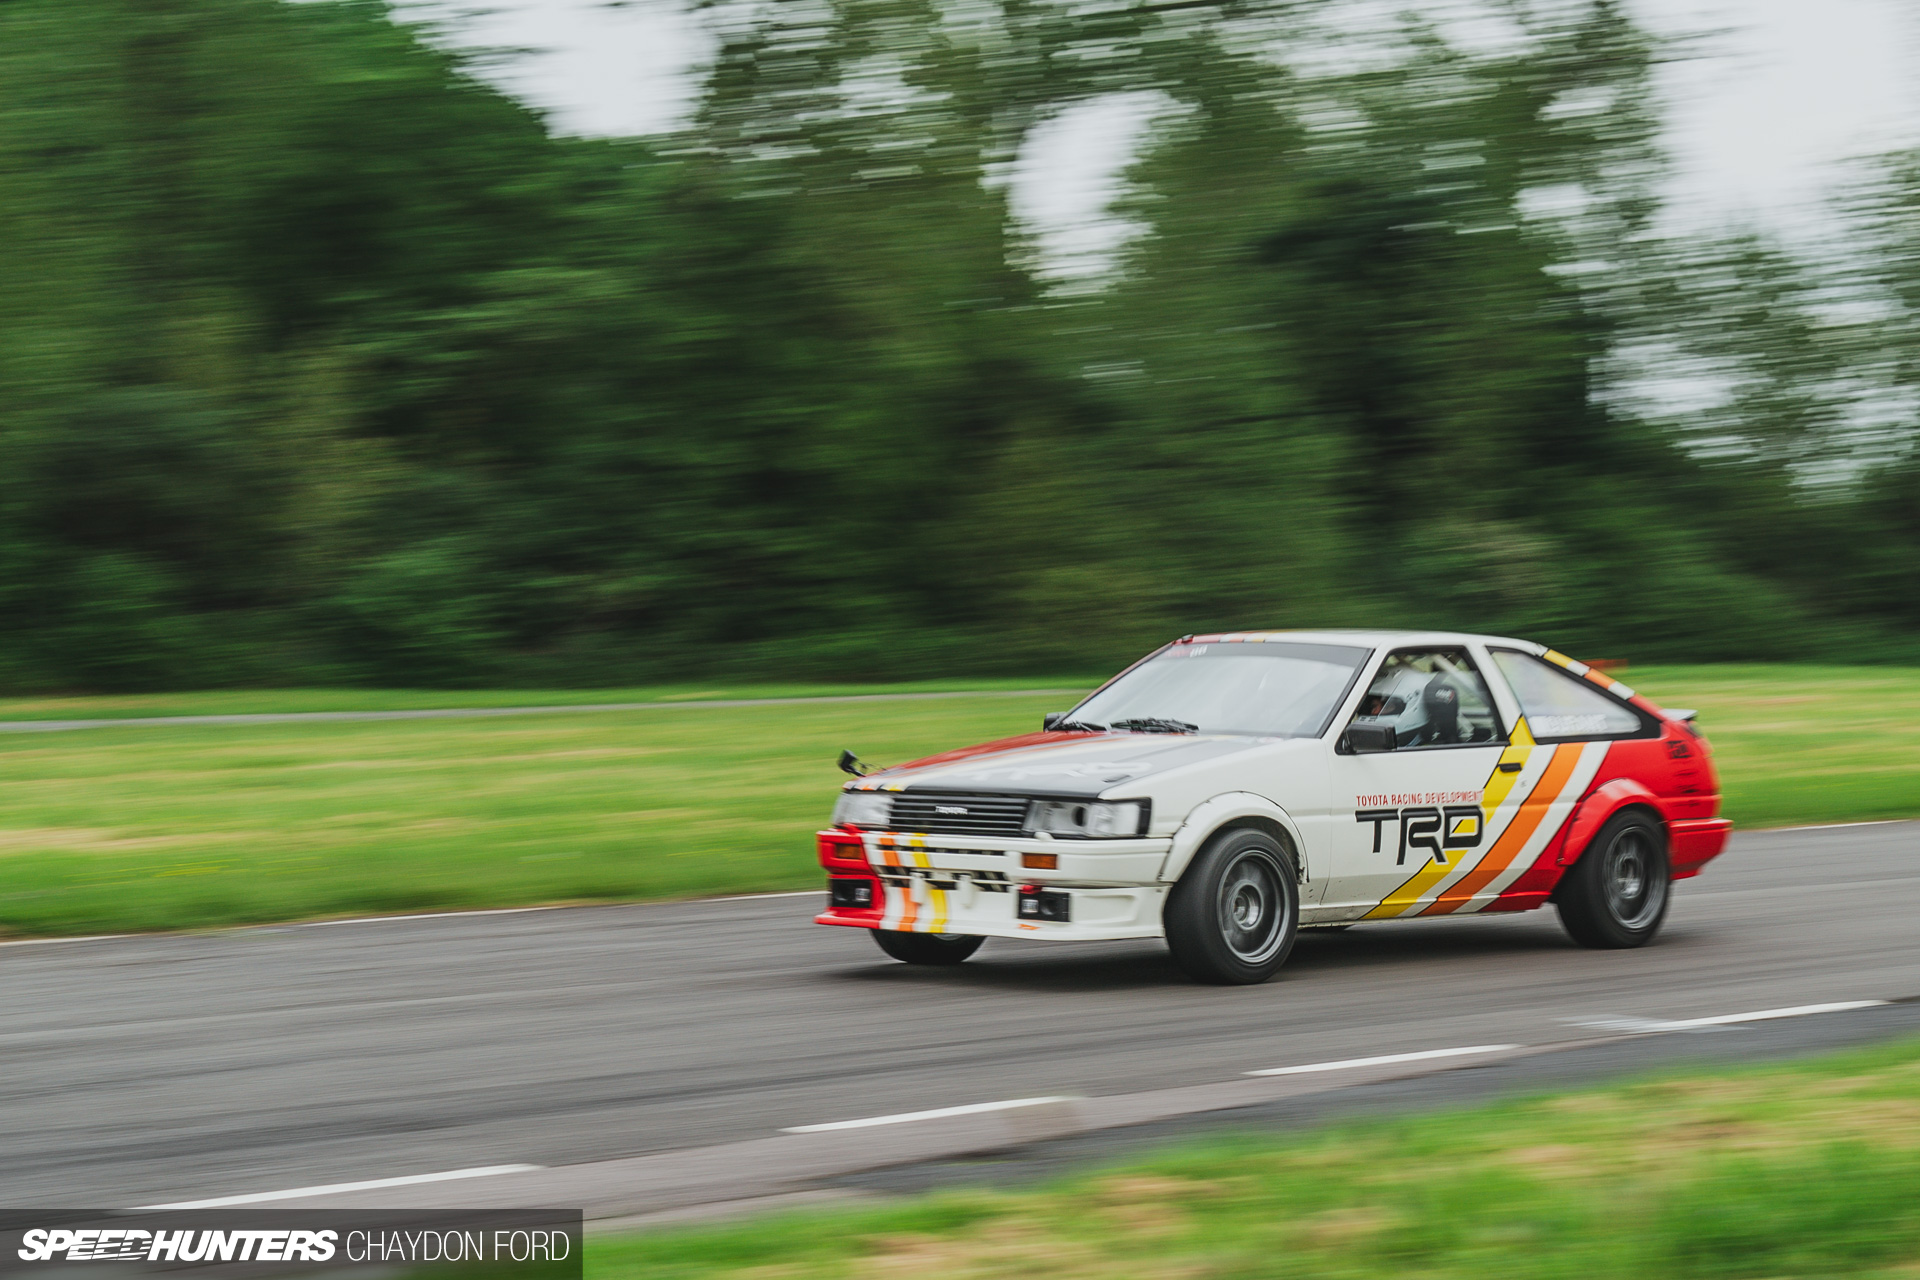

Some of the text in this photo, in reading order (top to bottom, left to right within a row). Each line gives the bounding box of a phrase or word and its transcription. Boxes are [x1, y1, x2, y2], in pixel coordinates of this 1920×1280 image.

[1356, 794, 1389, 807] TOYOTA
[1391, 792, 1423, 806] RACING
[1355, 805, 1483, 866] TRD
